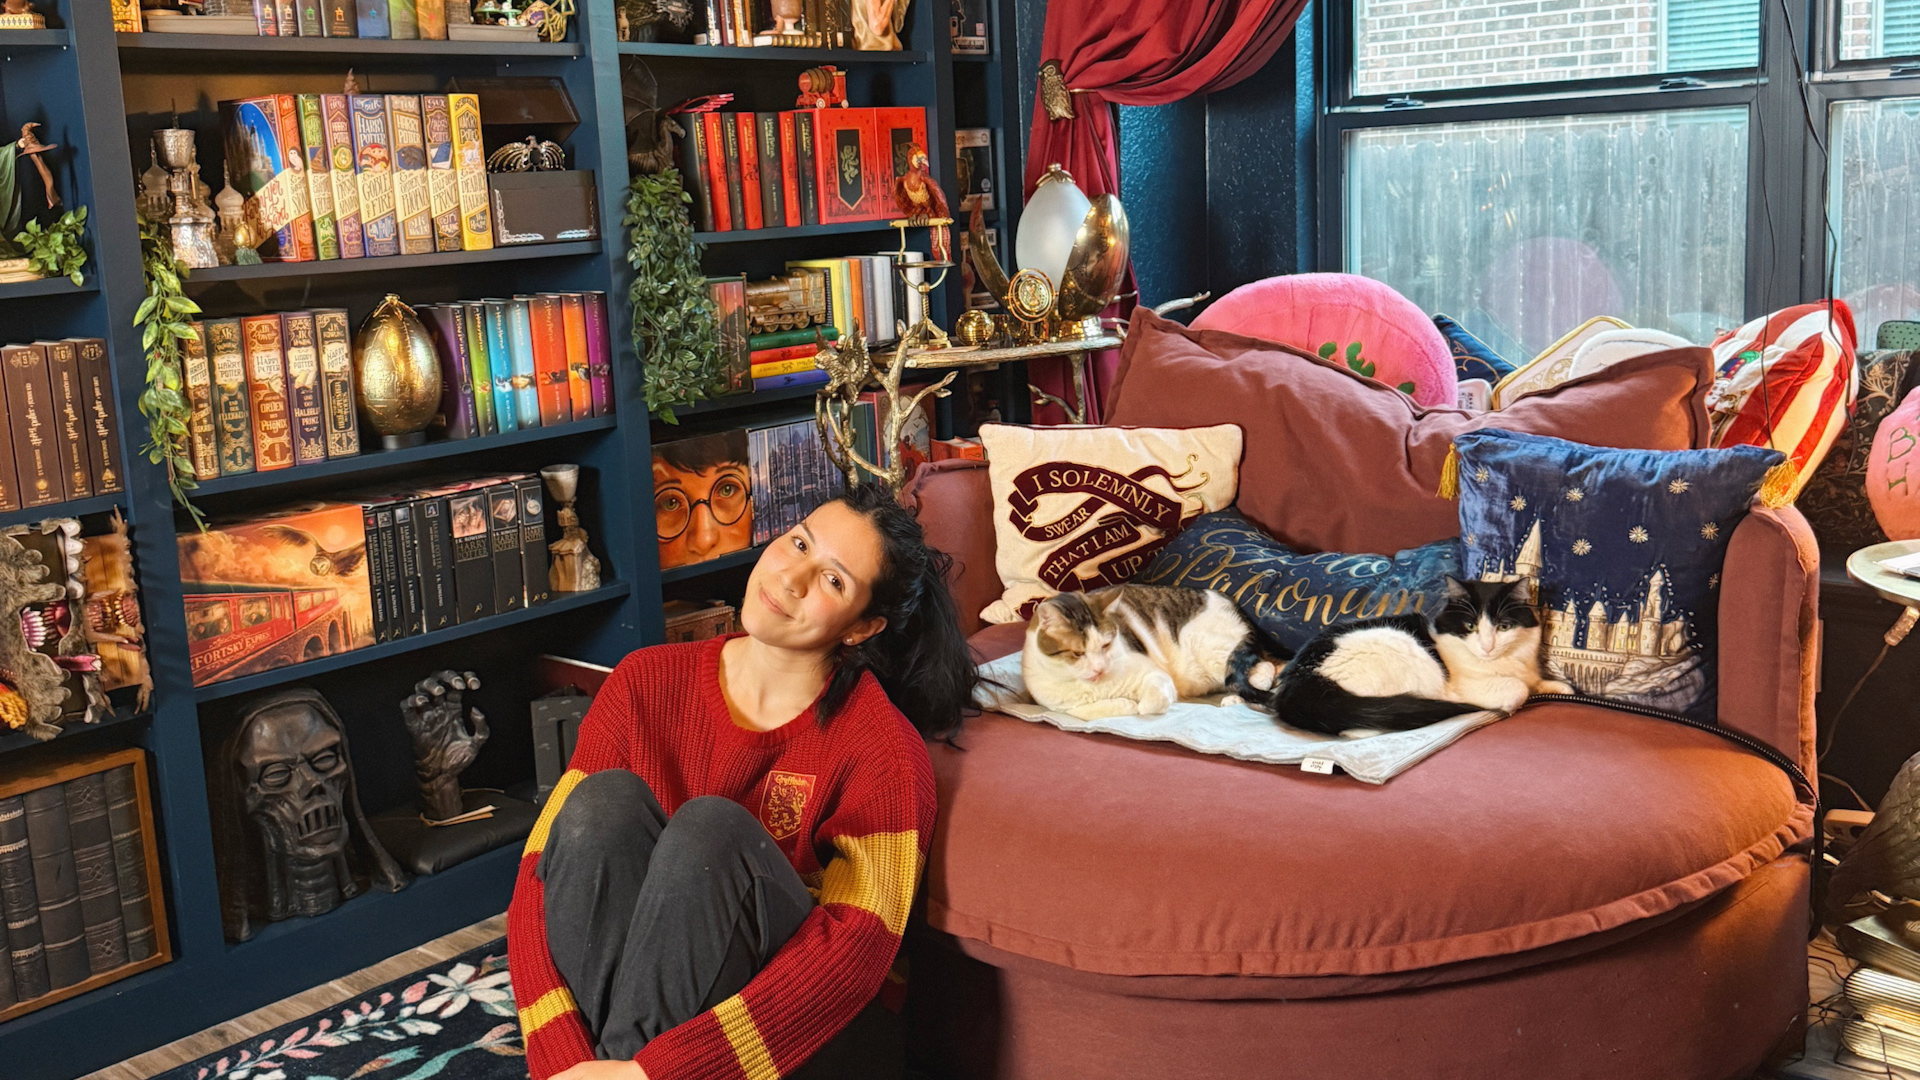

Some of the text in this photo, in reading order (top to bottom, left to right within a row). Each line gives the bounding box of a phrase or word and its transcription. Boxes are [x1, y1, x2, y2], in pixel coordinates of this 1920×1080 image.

[358, 114, 384, 133] HARRY
[396, 114, 419, 132] HARRY
[360, 133, 386, 147] POTTER
[398, 130, 420, 144] POTTER
[60, 351, 66, 359] 6
[327, 346, 345, 361] HARRY
[218, 361, 240, 370] HARRY
[294, 361, 313, 369] POTTER
[328, 355, 346, 369] POTTER
[219, 369, 241, 378] POTTER
[260, 402, 284, 413] ORDEN
[302, 416, 319, 426] PRINZ
[1031, 470, 1173, 523] I SOLEMNLY
[1045, 506, 1092, 539] SWEAR
[402, 525, 411, 547] HARRY
[432, 520, 440, 541] HARRY
[371, 533, 379, 555] HARRY
[385, 529, 394, 552] HARRY
[457, 539, 486, 552] HARRY
[494, 533, 518, 544] HARRY
[494, 541, 519, 552] POTTER
[1043, 525, 1132, 580] THAT I AM
[457, 549, 488, 560] POTTER
[1111, 556, 1143, 580] UP
